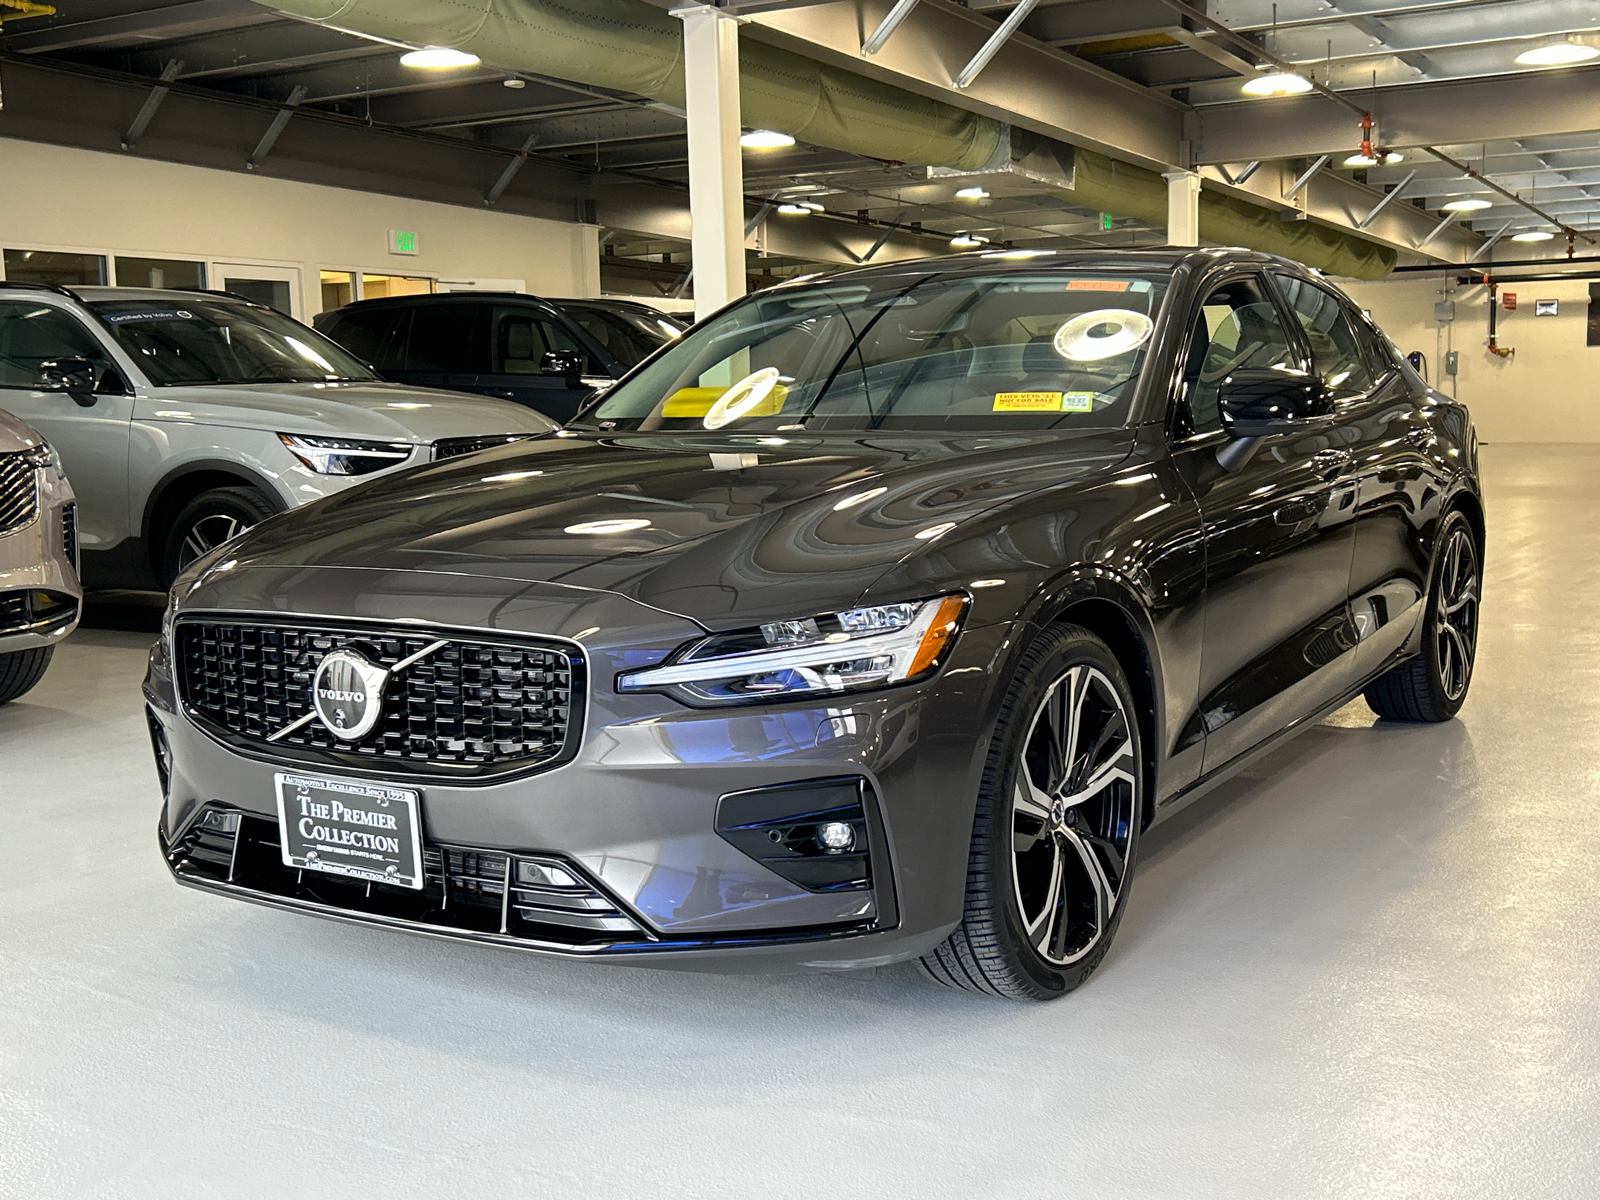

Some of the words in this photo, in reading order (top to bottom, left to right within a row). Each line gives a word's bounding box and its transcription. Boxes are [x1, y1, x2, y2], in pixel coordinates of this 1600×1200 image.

[397, 231, 415, 251] EXIT
[111, 313, 142, 321] Certified
[319, 688, 365, 702] VOLVO
[285, 775, 325, 787] AUTOMOTIVE
[326, 782, 364, 793] EXCELLENCE
[365, 787, 386, 796] SINCE
[386, 790, 405, 800] 1995
[296, 795, 330, 820] THE
[331, 800, 397, 830] PREMIER
[299, 817, 399, 853] COLLECTION
[316, 844, 350, 855] EVERYTHING
[350, 848, 369, 859] STARTS
